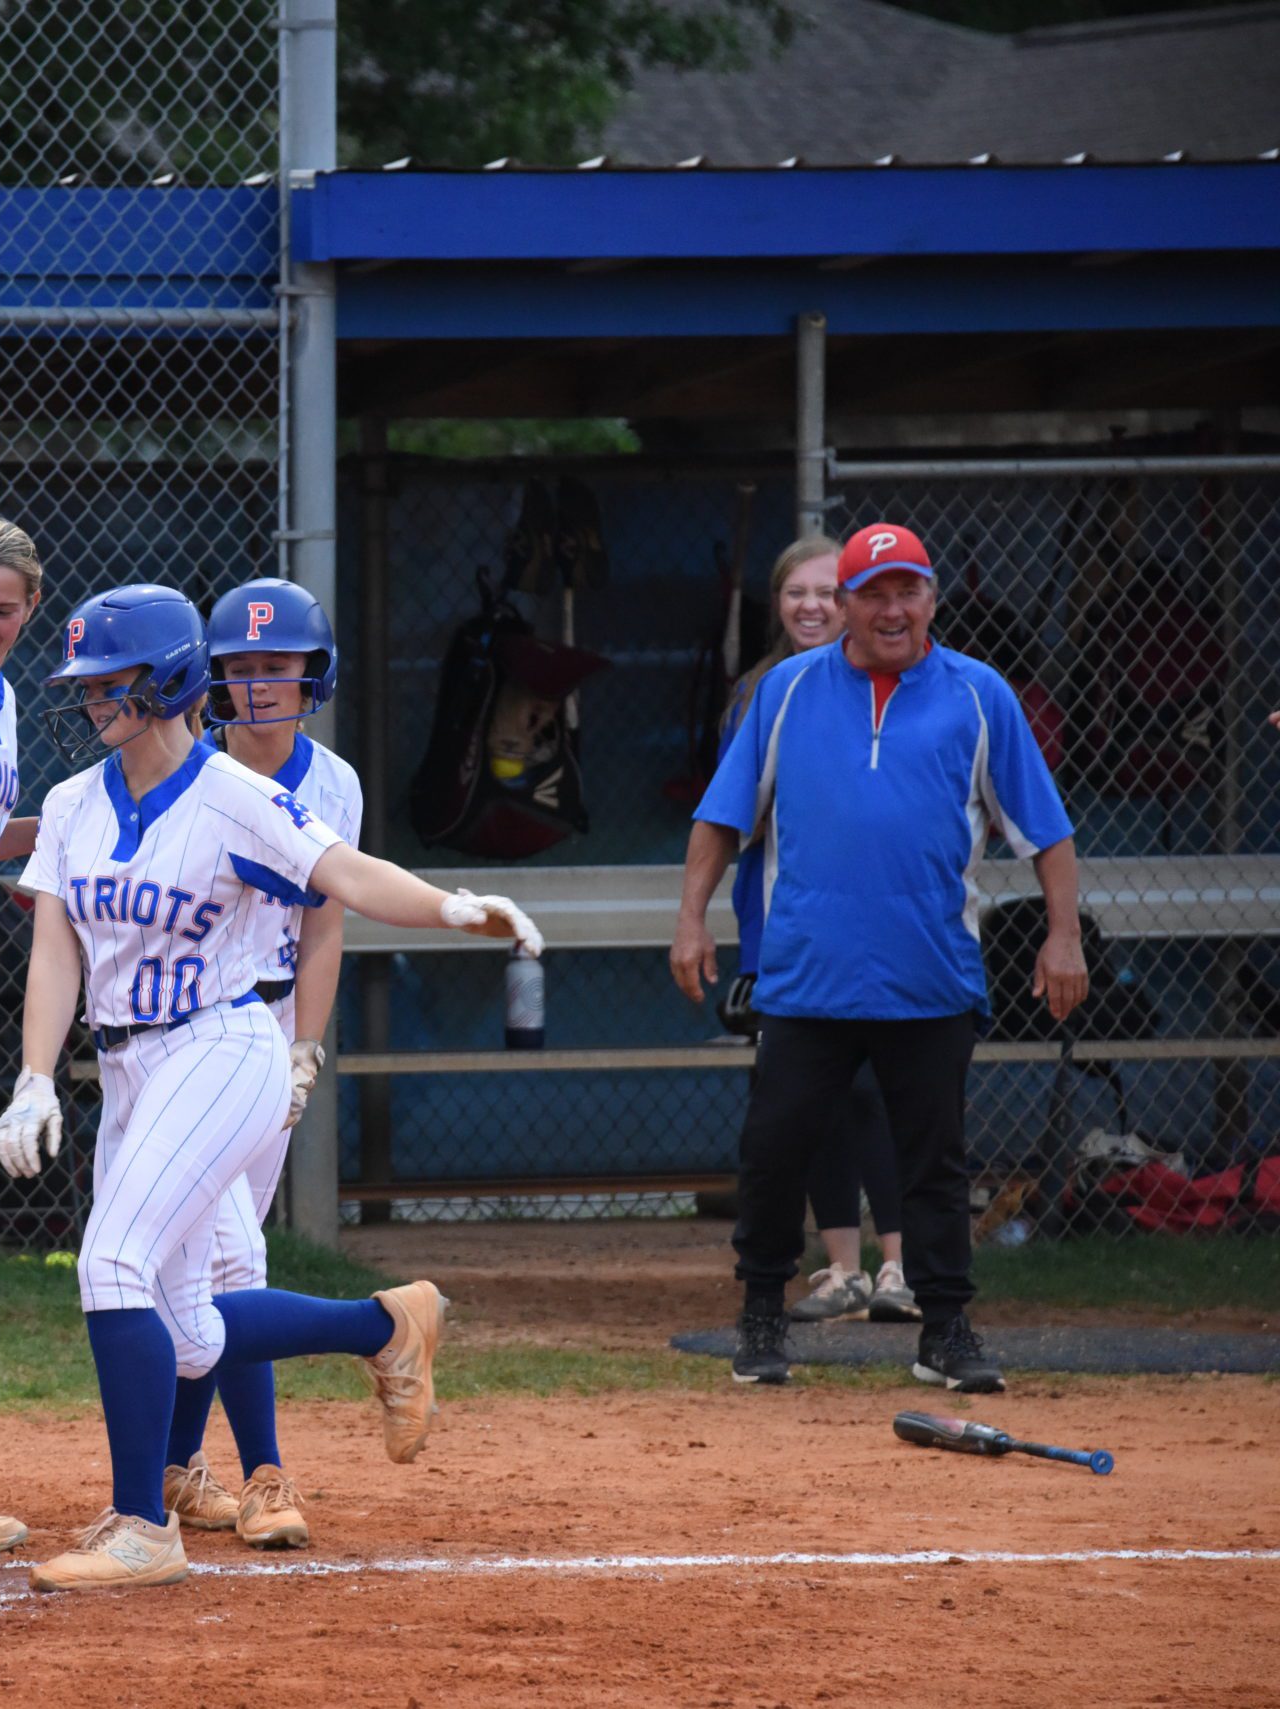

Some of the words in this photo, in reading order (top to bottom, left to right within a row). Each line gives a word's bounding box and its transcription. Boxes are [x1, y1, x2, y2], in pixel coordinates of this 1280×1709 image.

[868, 532, 897, 561] P
[67, 618, 85, 660] P
[247, 602, 274, 640] P
[66, 875, 225, 944] TRIOTS
[129, 956, 207, 1024] 00
